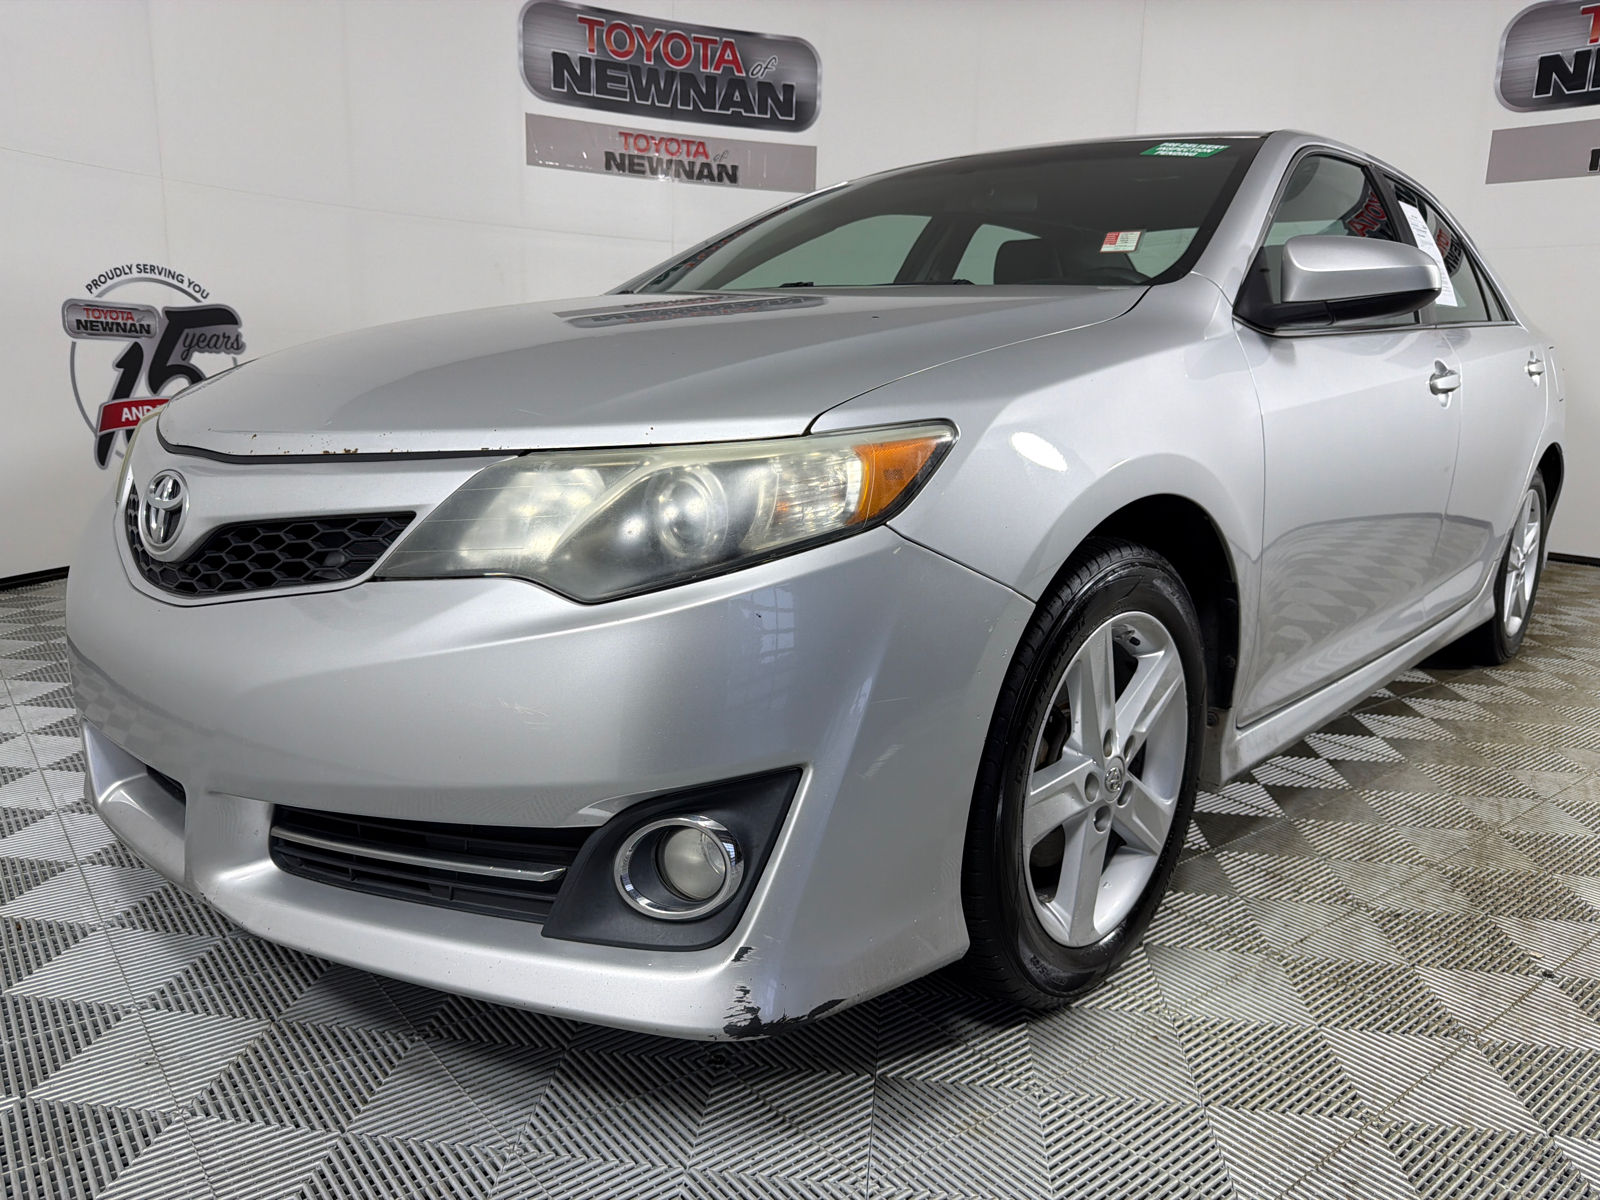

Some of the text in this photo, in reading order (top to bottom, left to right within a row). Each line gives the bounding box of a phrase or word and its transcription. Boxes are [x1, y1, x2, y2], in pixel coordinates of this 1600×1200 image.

[577, 16, 777, 79] TOYOTA of
[551, 51, 796, 120] NEWNAN
[618, 132, 710, 160] TOYOTA
[604, 151, 739, 184] NEWNAN
[85, 263, 210, 300] PROUDLY SERVING YOU
[75, 319, 151, 335] NEWNAN
[82, 307, 135, 322] TOYOTA
[181, 331, 243, 362] years
